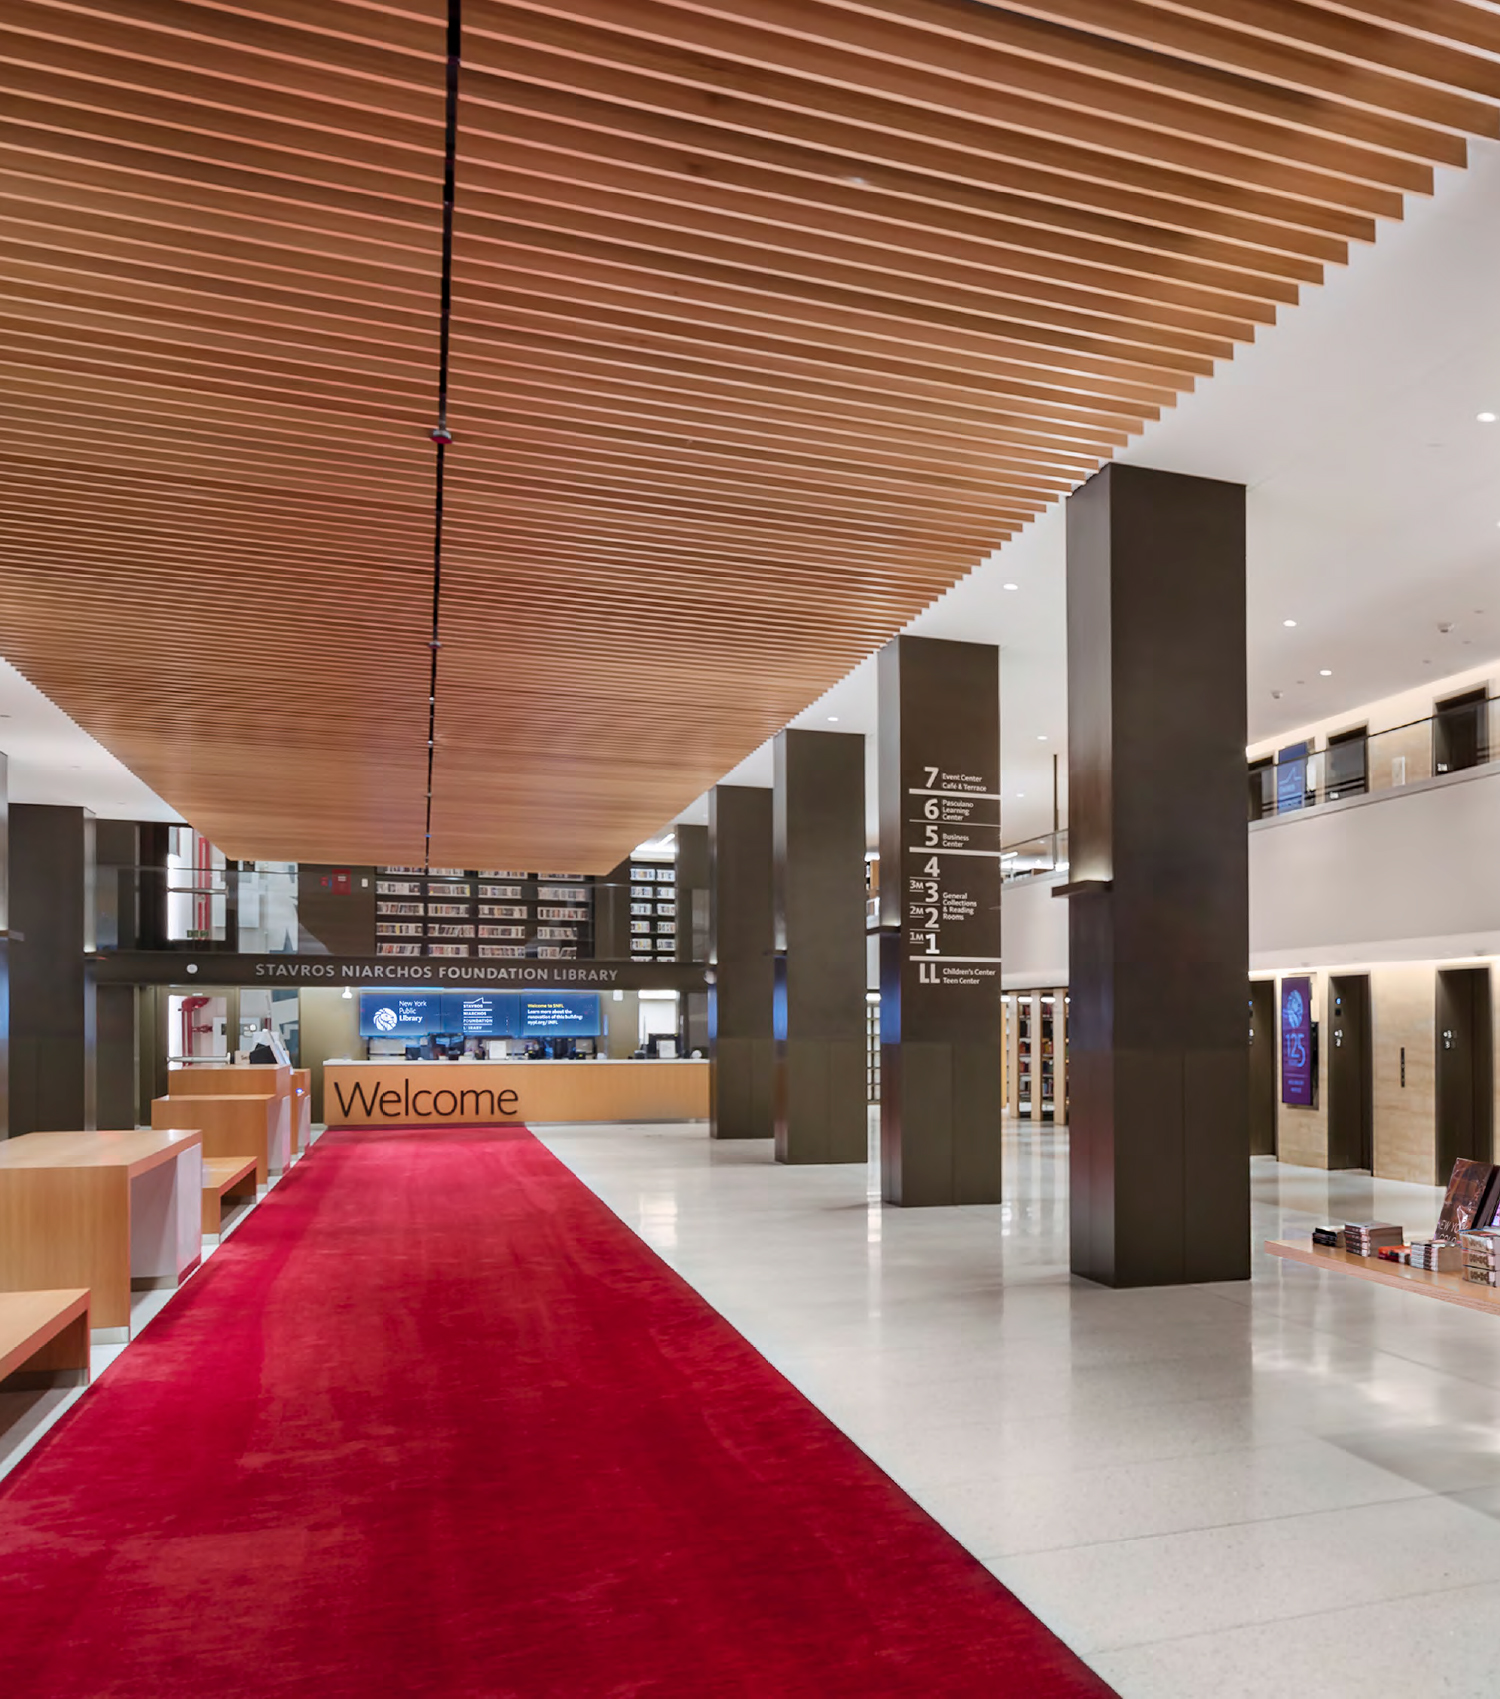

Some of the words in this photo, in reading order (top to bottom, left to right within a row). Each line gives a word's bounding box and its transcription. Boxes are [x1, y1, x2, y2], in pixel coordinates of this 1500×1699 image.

[924, 767, 939, 788] 7
[961, 774, 982, 782] Center
[963, 784, 987, 792] Terrace
[924, 798, 939, 820] 6
[942, 807, 970, 816] Learning
[925, 825, 939, 846] 5
[942, 833, 970, 841] Business
[924, 856, 940, 877] 4
[909, 880, 924, 890] 3M
[925, 881, 939, 903] 3
[942, 892, 967, 900] General
[942, 899, 977, 907] Collections
[909, 906, 924, 915] 2M
[949, 907, 975, 916] Reading
[925, 907, 939, 929] 2
[909, 932, 924, 941] 1M
[925, 933, 940, 955] 1
[255, 964, 335, 977] STAVROS
[341, 965, 432, 979] NIARCHOS
[439, 967, 548, 980] FOUNDATION
[554, 969, 618, 981] LIBRARY
[920, 963, 940, 984] LL
[399, 1015, 423, 1023] Library
[334, 1078, 519, 1118] Welcome
